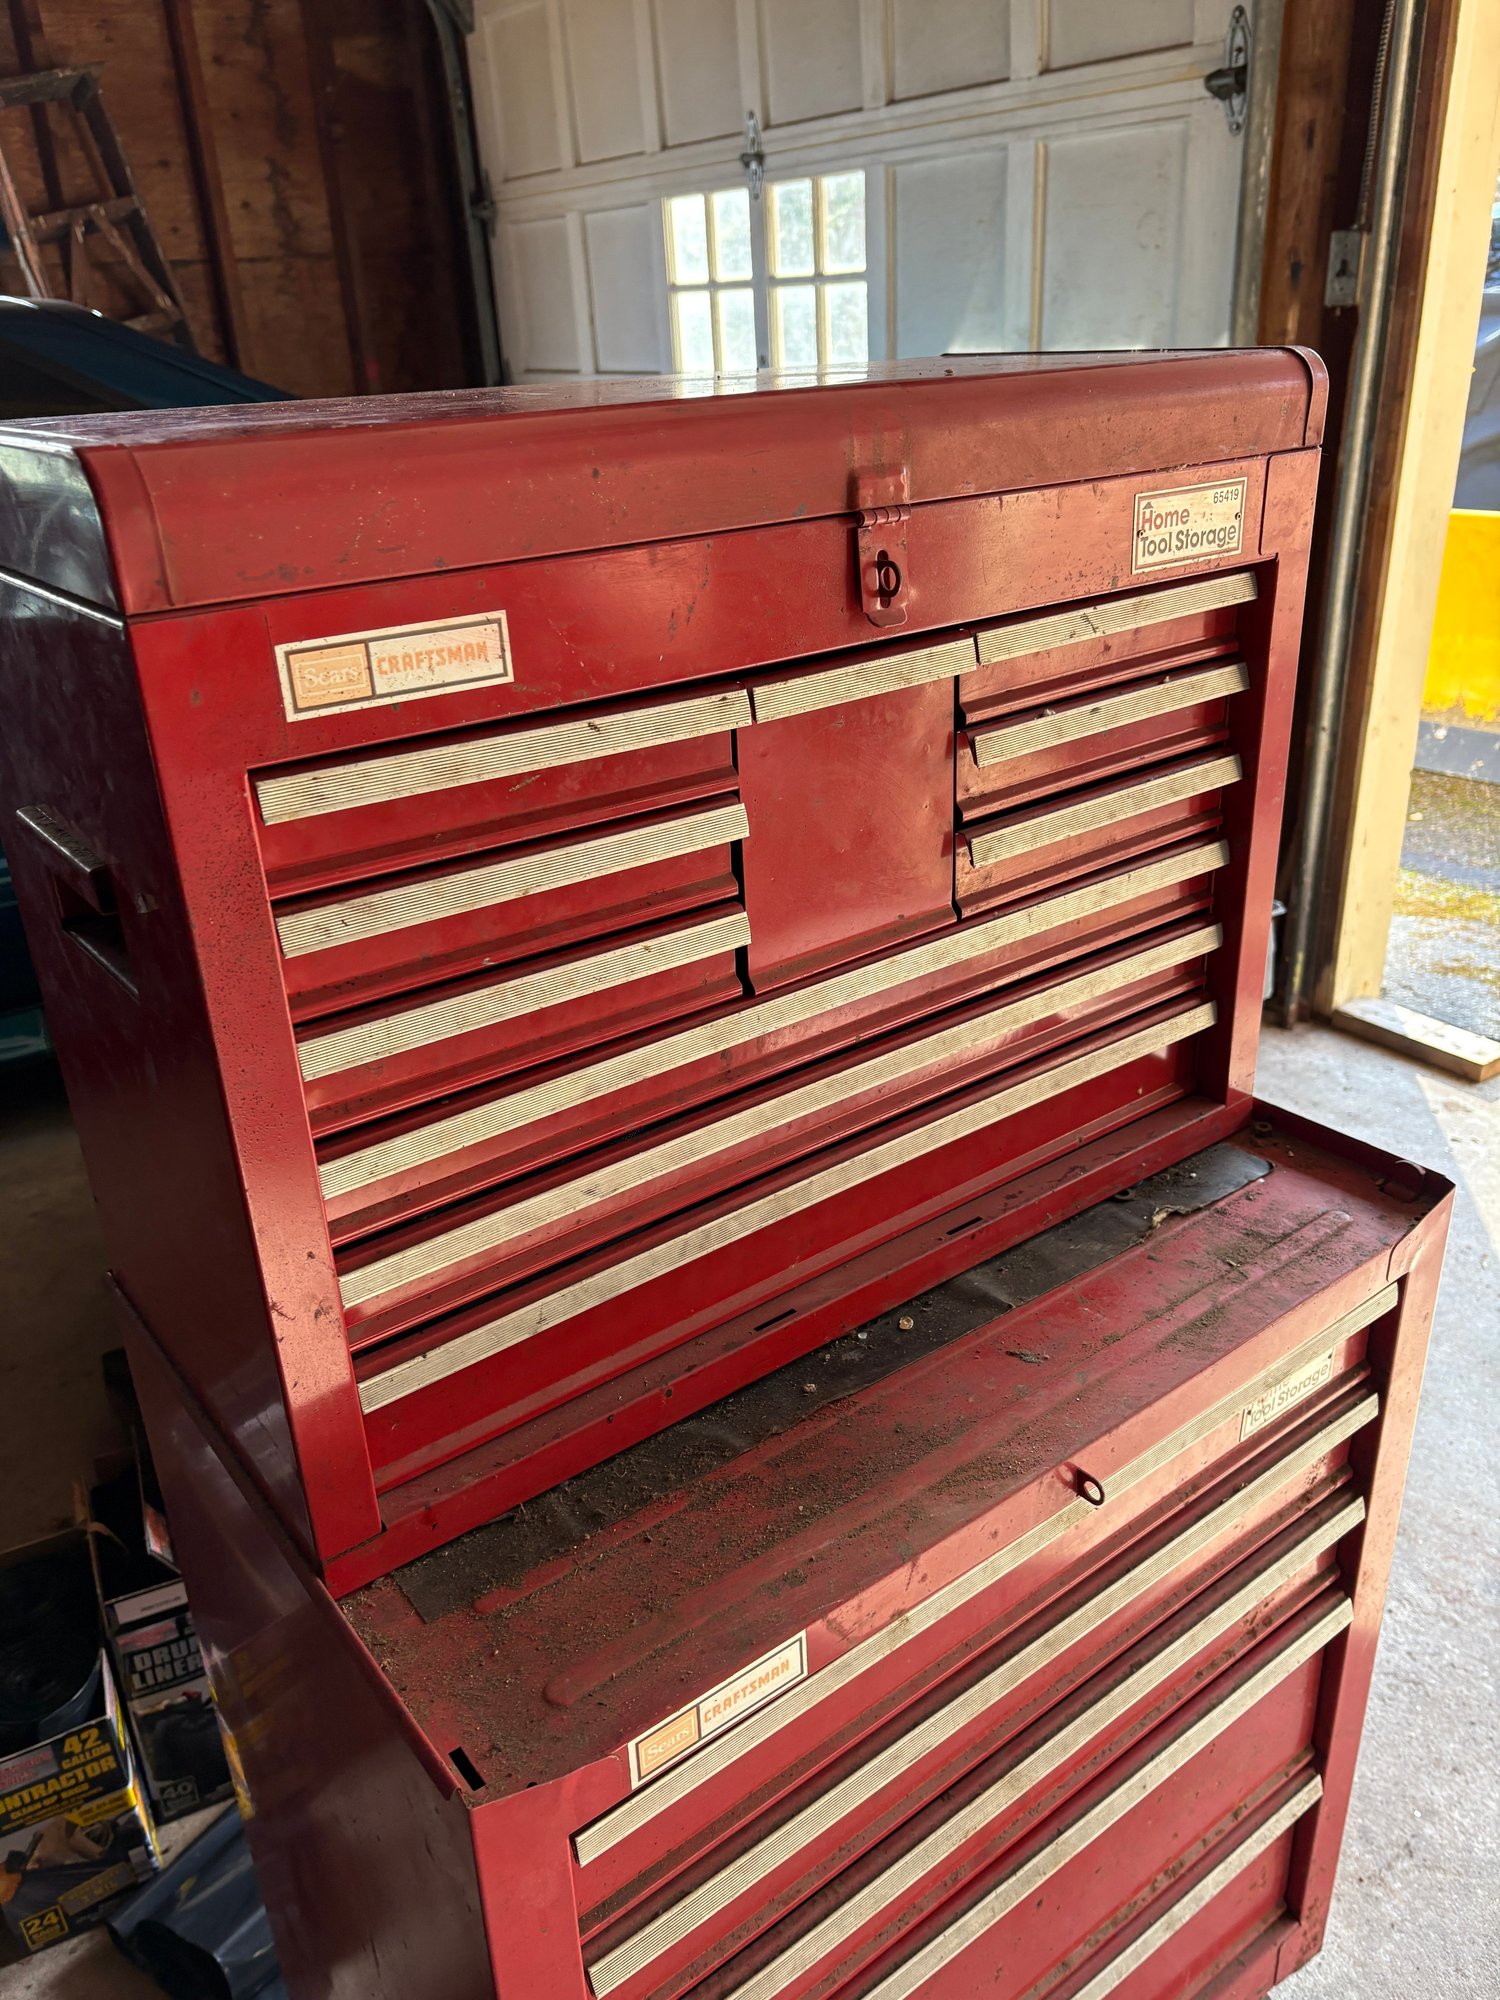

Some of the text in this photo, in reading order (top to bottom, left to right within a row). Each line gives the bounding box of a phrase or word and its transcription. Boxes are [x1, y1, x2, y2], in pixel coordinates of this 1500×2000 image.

[1213, 488, 1240, 504] 65419
[1141, 508, 1190, 531] Home
[1140, 525, 1237, 557] Tool Storage
[376, 641, 489, 676] CRAFTSMAN
[303, 664, 360, 688] Sears
[1250, 1364, 1329, 1426] Tool Storage
[703, 1659, 790, 1724] CRAFTSMAN
[63, 1727, 101, 1754] 42
[647, 1727, 690, 1757] Sears
[61, 1742, 112, 1769] GALLON
[25, 1910, 59, 1936] 24
